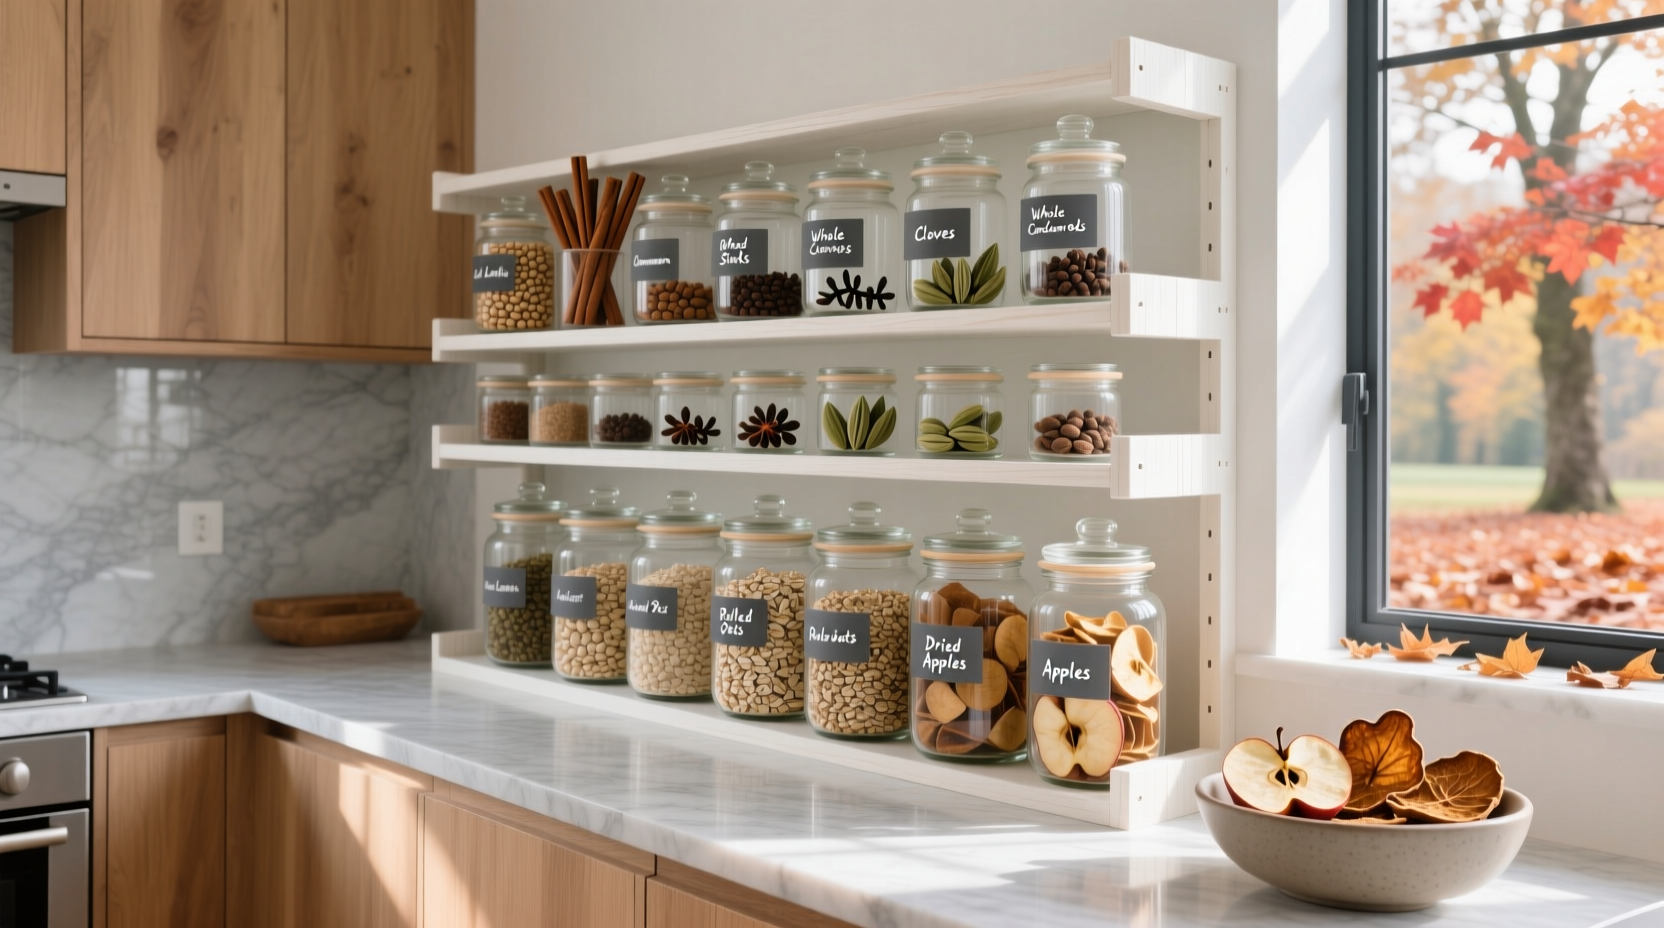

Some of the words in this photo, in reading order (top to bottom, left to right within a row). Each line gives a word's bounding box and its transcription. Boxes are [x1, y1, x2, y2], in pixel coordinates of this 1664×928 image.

[1031, 204, 1065, 220] Whole
[811, 226, 845, 242] Whole
[914, 225, 955, 241] Cloves
[924, 634, 962, 652] Dried
[922, 651, 967, 674] Apples
[1041, 658, 1091, 685] Apples
